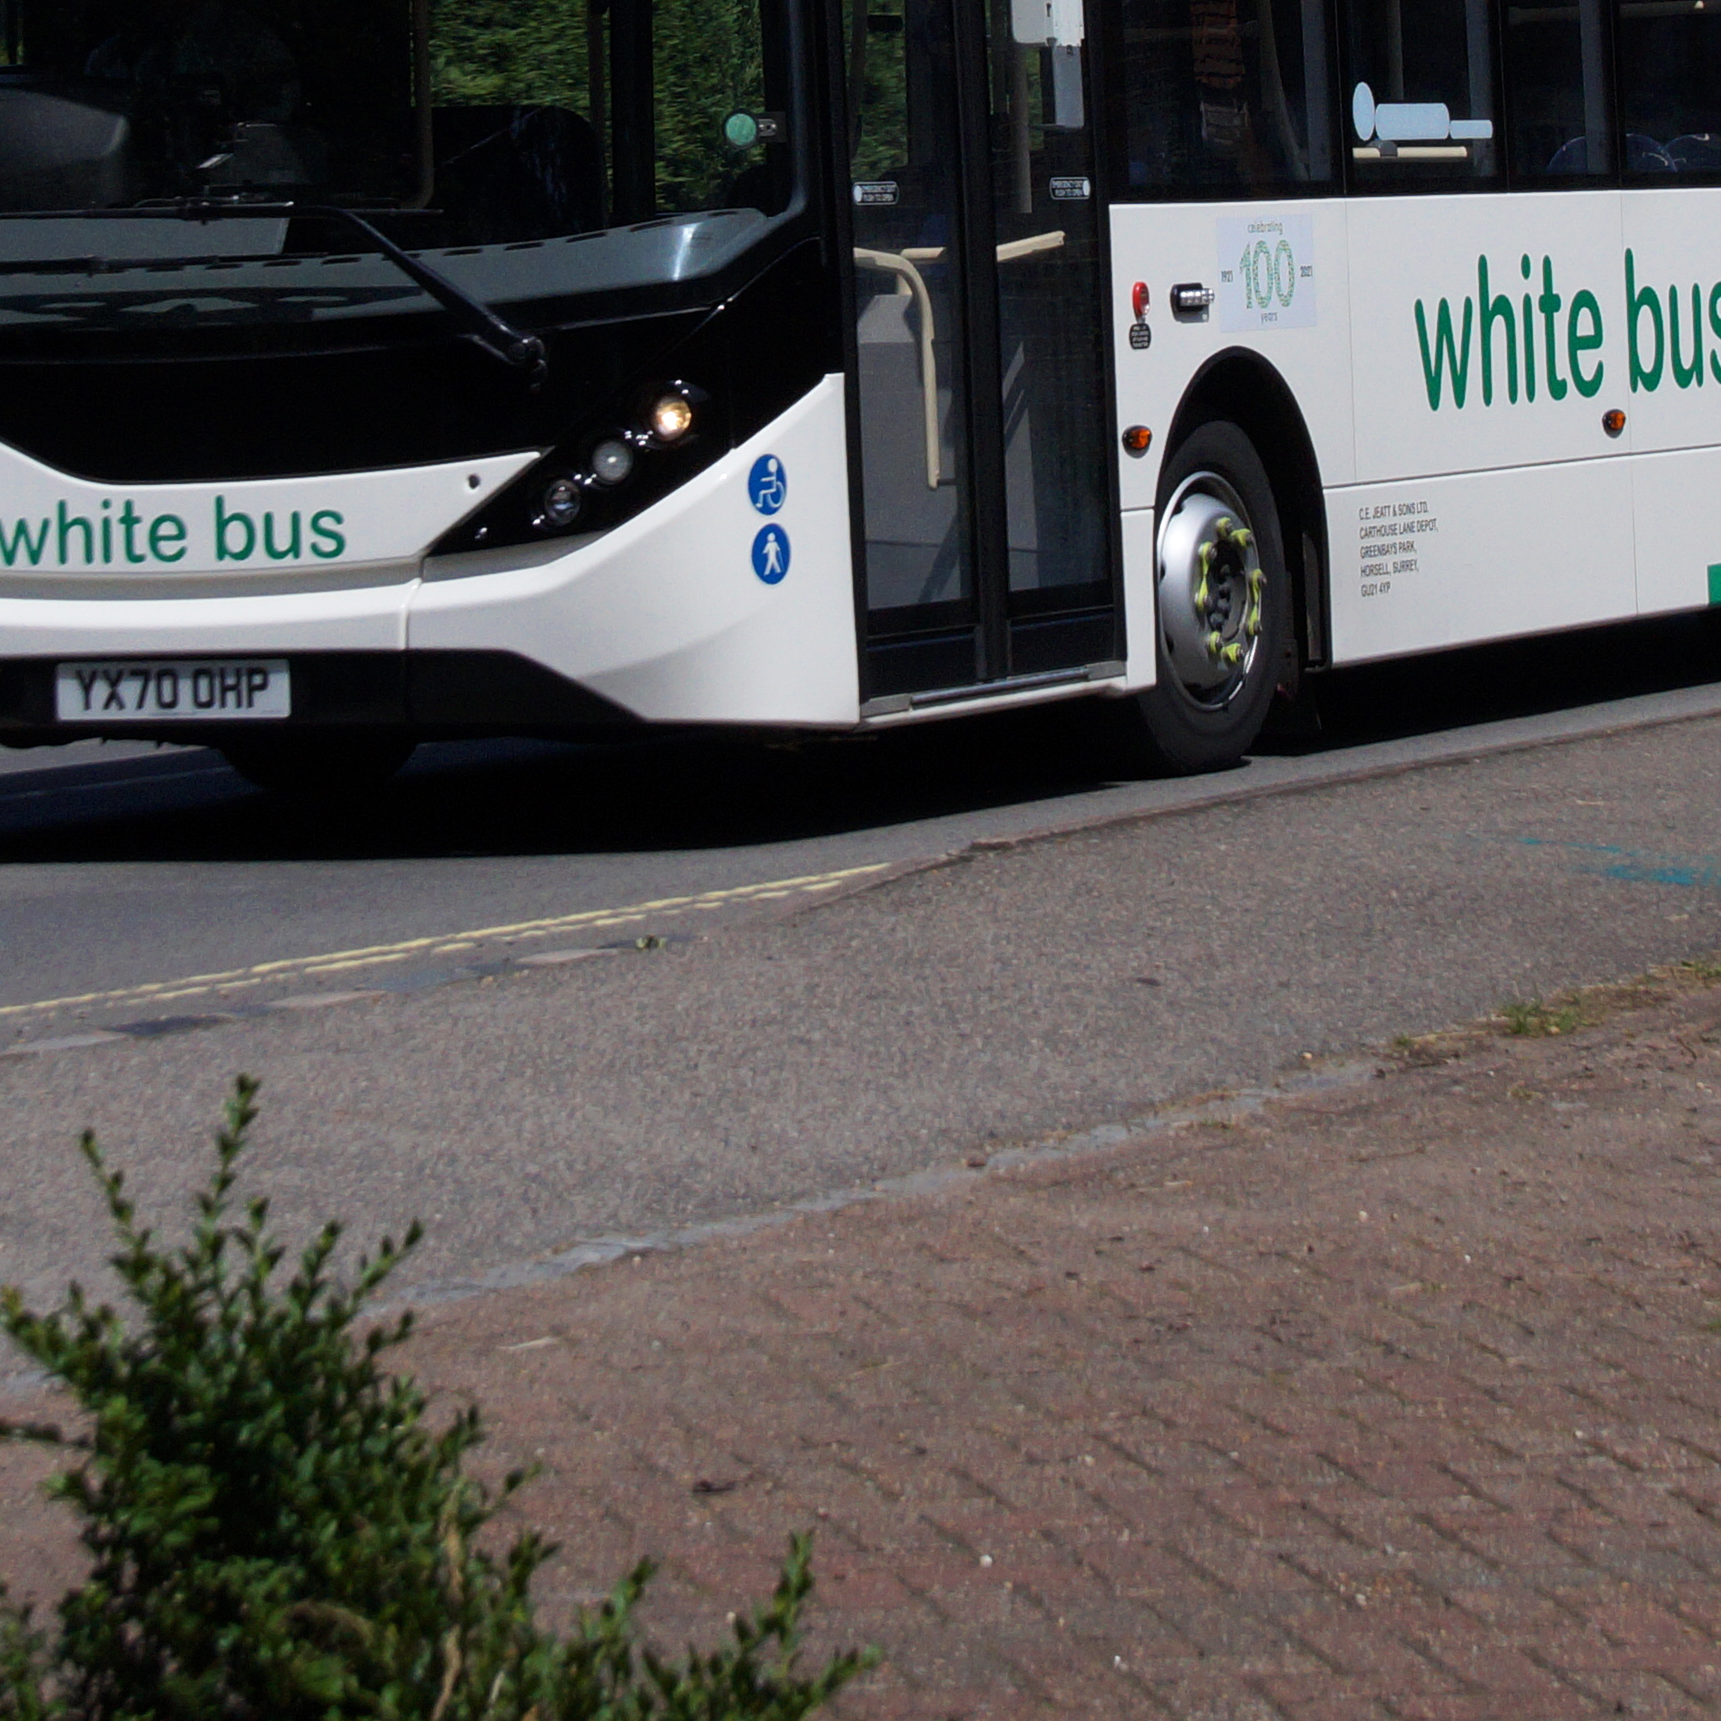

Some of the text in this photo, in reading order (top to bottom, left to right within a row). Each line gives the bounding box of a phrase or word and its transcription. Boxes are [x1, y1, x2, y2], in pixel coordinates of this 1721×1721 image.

[1247, 221, 1283, 236] celebrating
[1239, 239, 1295, 310] 100
[1414, 253, 1604, 411] white
[215, 494, 346, 562] bus
[1398, 502, 1415, 516] SONS
[1399, 520, 1416, 535] LANE
[75, 666, 270, 711] YX70 OHP
